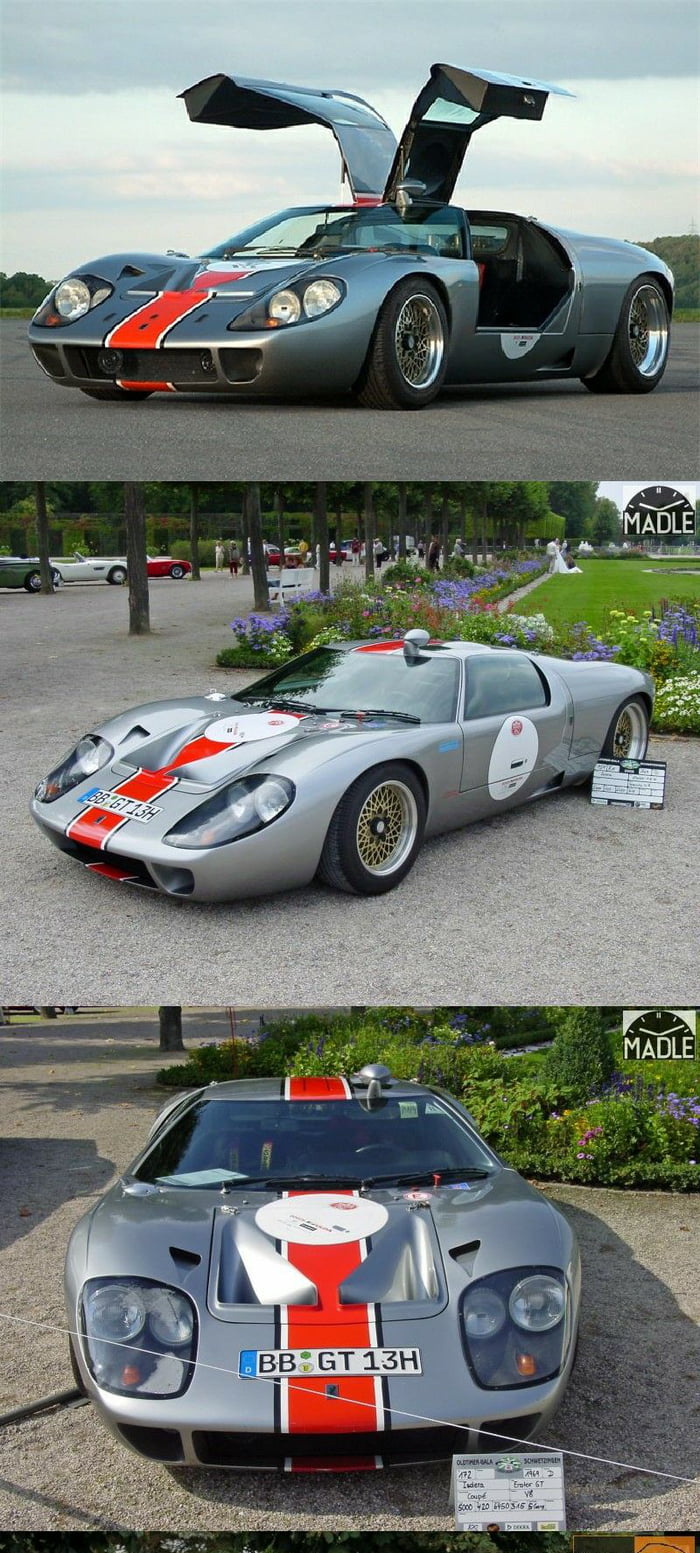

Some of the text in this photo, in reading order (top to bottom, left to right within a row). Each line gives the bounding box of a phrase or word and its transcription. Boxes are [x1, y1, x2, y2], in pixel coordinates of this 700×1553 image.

[88, 791, 160, 820] BB GT 13H
[259, 1350, 419, 1373] BB GT 13H
